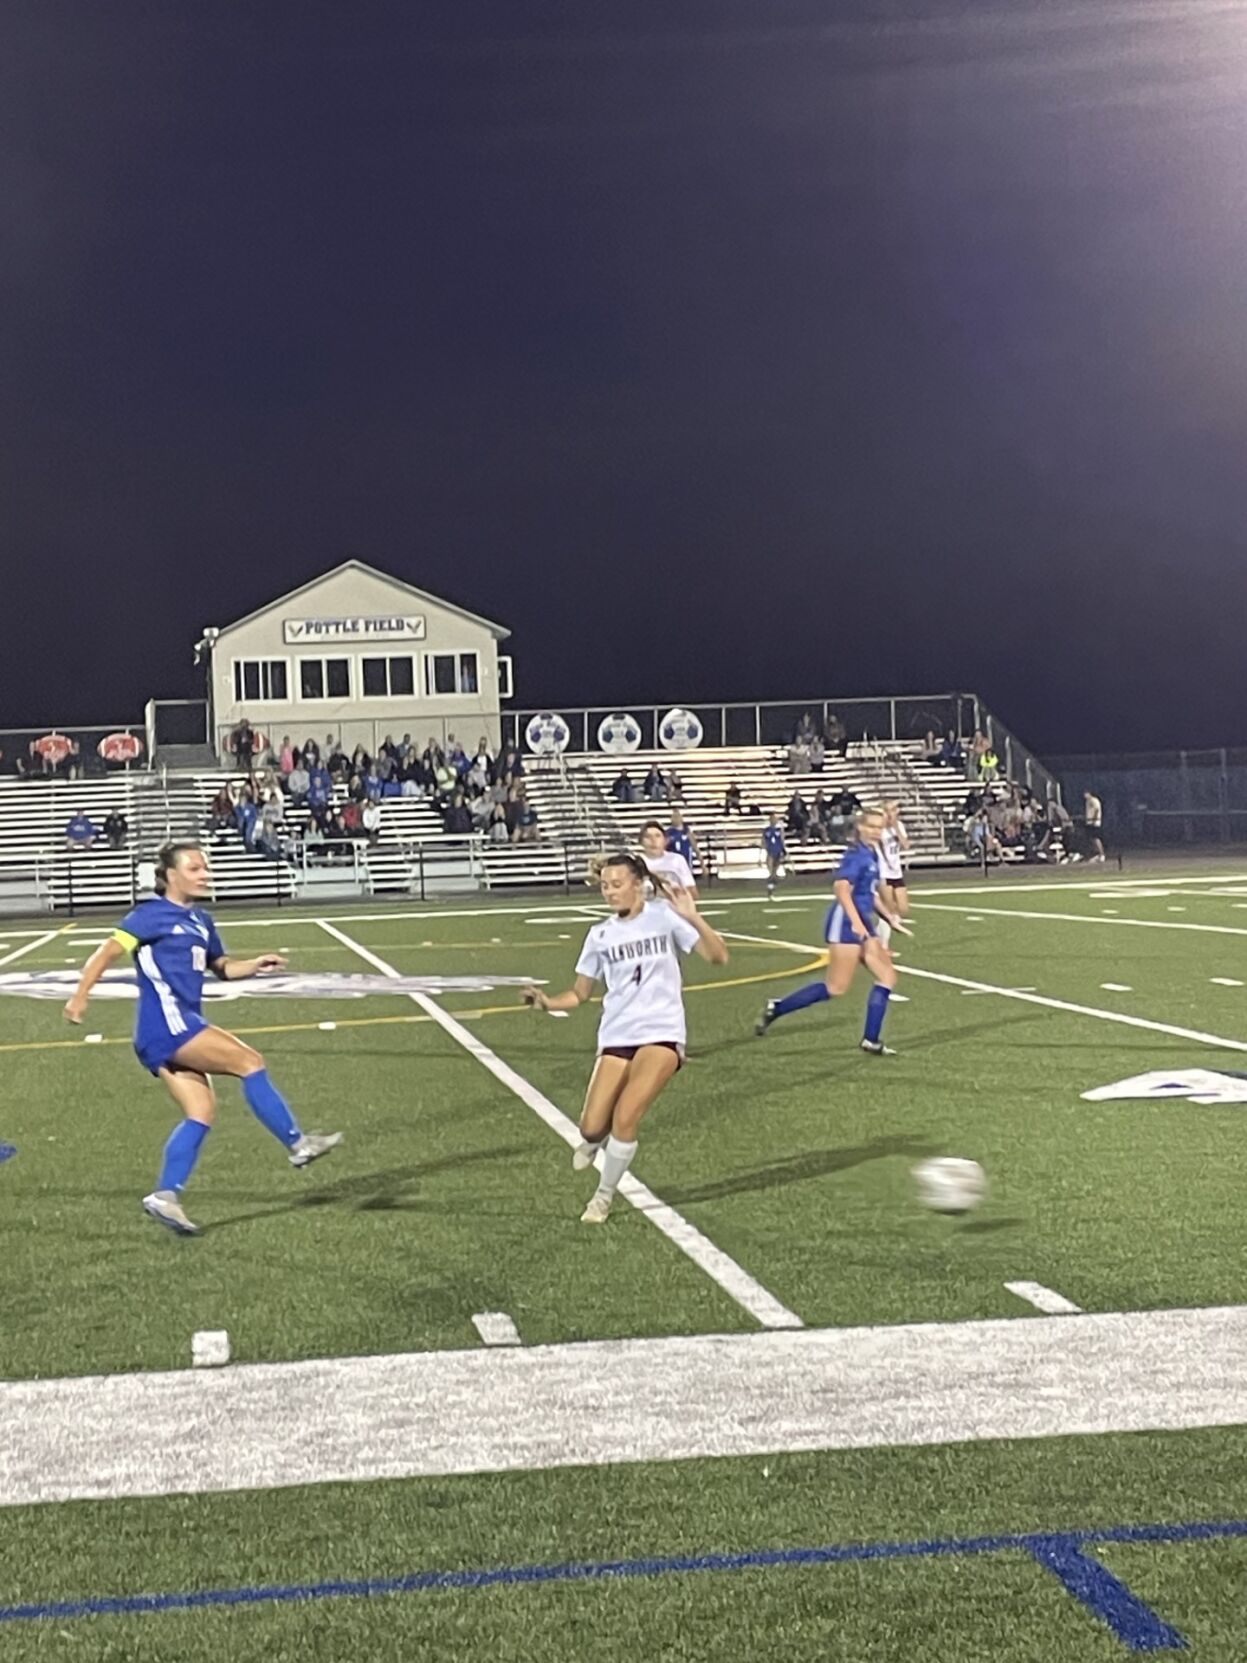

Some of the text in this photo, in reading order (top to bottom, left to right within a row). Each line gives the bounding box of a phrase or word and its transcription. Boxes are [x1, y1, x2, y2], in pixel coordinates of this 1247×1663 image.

[305, 618, 404, 634] POTTLE FIELD
[602, 934, 667, 964] LLSWORTH
